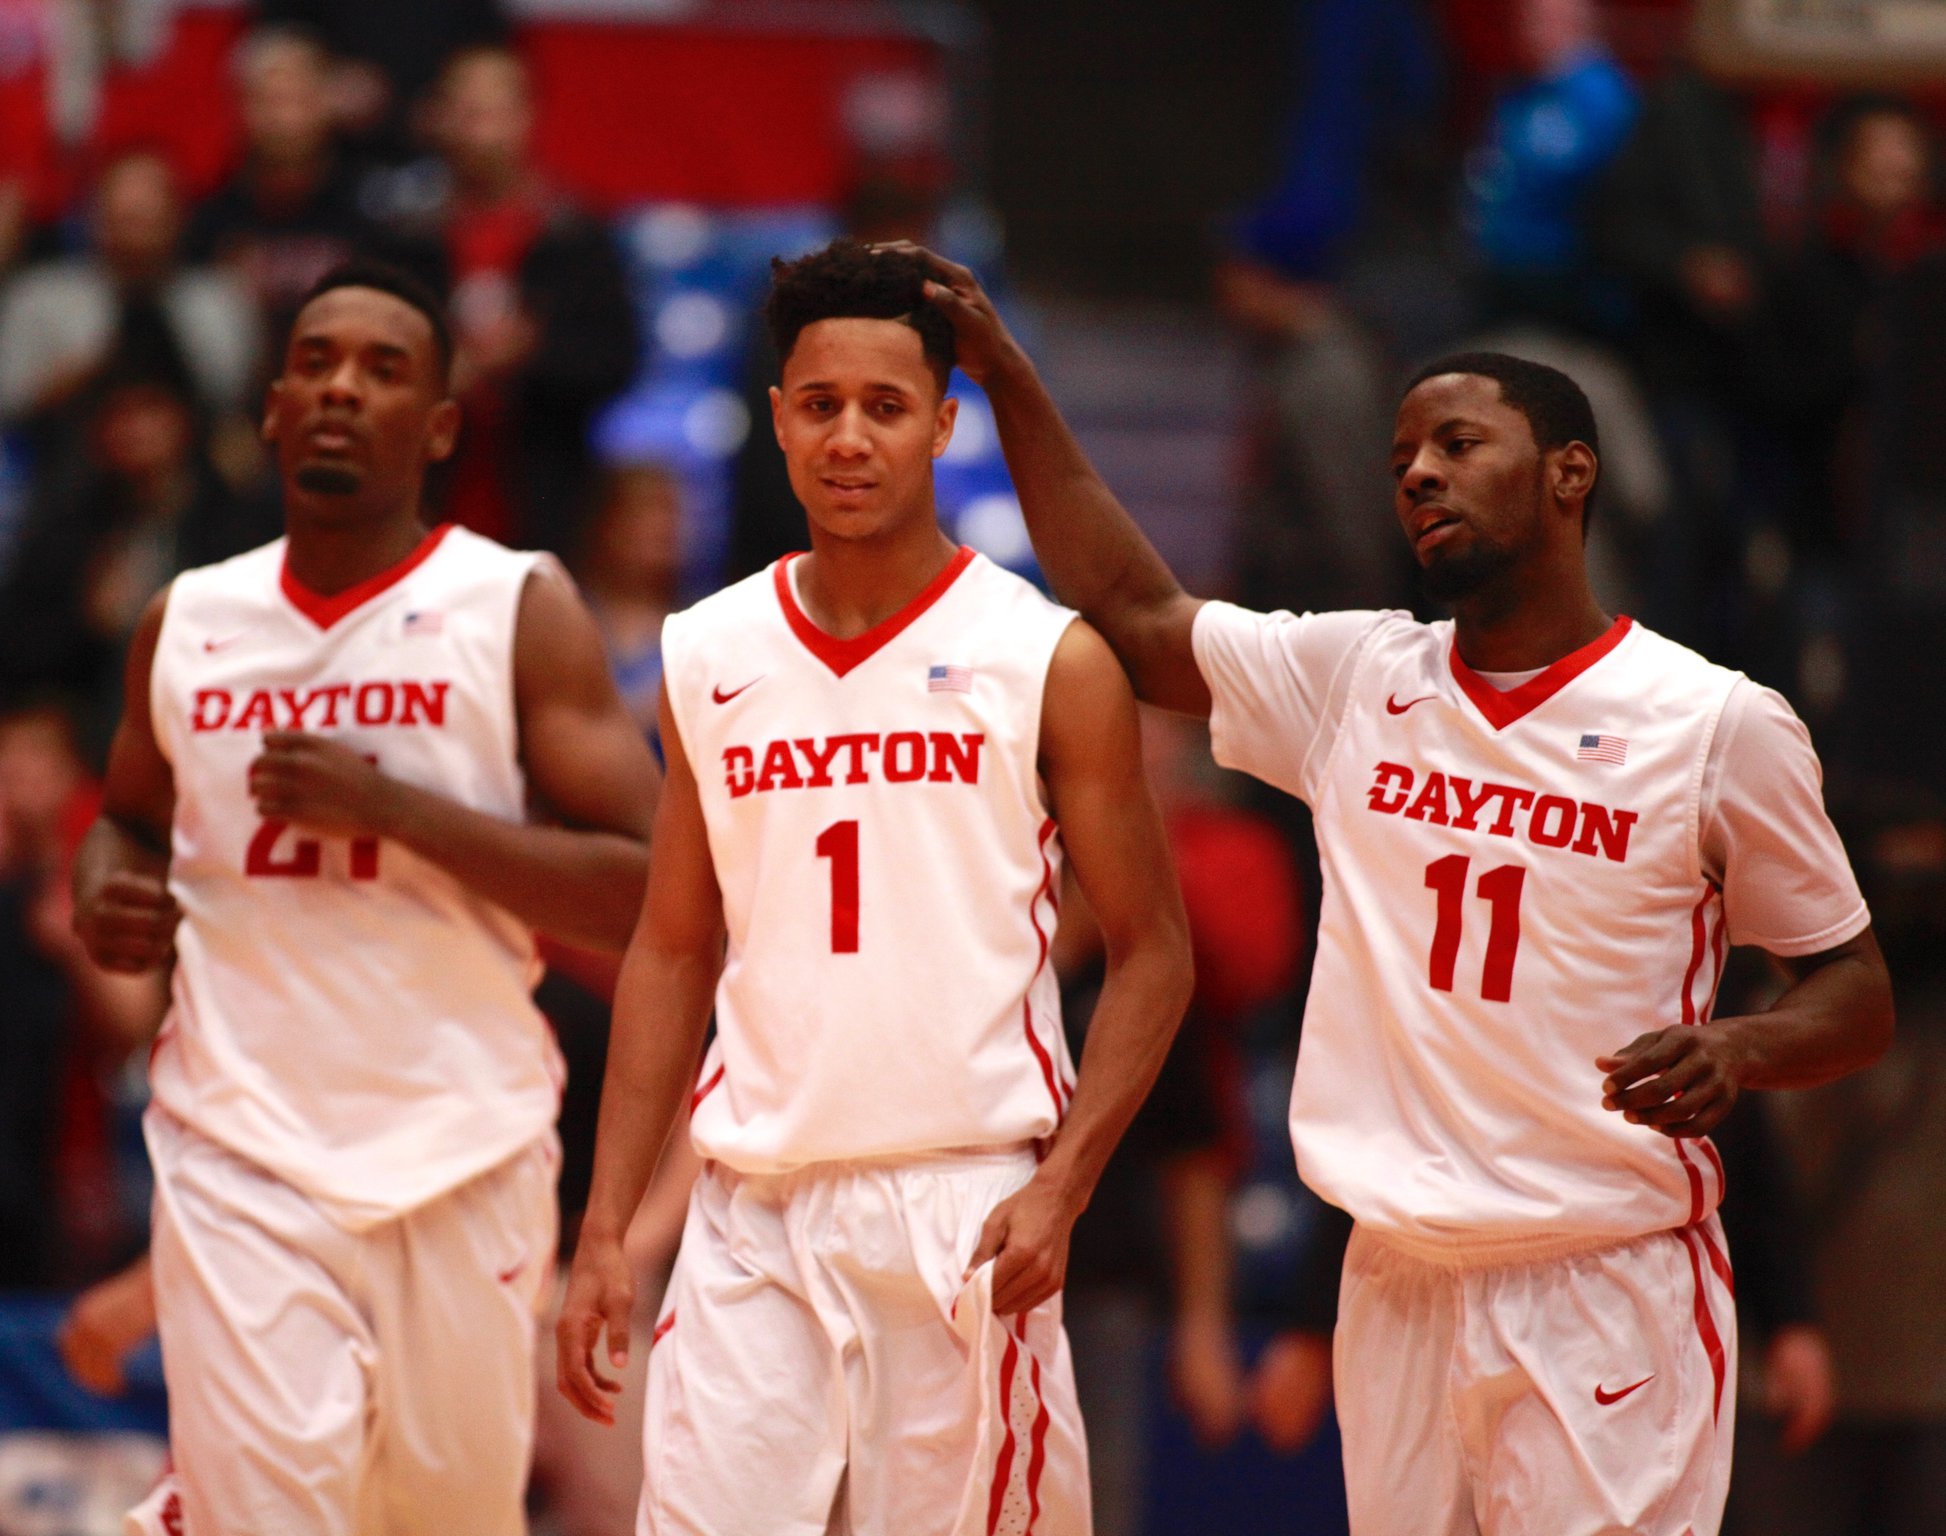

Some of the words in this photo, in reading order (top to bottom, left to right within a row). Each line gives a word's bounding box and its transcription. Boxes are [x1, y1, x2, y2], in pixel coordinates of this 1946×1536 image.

[192, 681, 449, 733] DAYTON
[721, 731, 985, 799] DAYTON
[1366, 760, 1639, 863] DAYTON
[816, 820, 859, 953] 1
[1424, 853, 1526, 1003] 11
